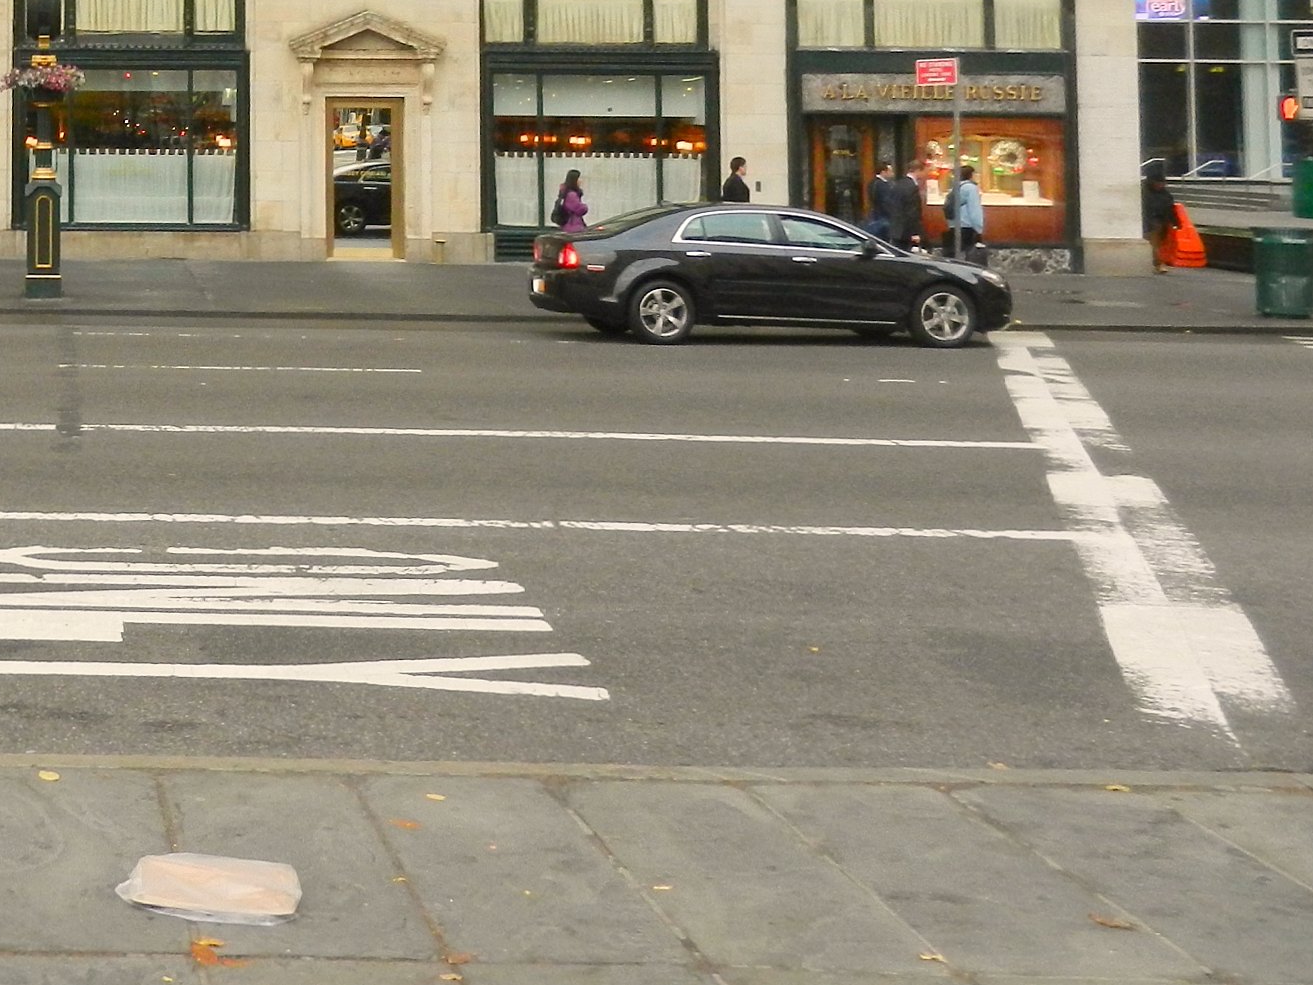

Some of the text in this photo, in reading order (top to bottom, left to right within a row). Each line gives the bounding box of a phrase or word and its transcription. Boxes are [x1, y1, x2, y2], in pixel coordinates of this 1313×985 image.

[1151, 0, 1185, 14] early
[823, 83, 1043, 102] A LA VIEILLE RUSSIE
